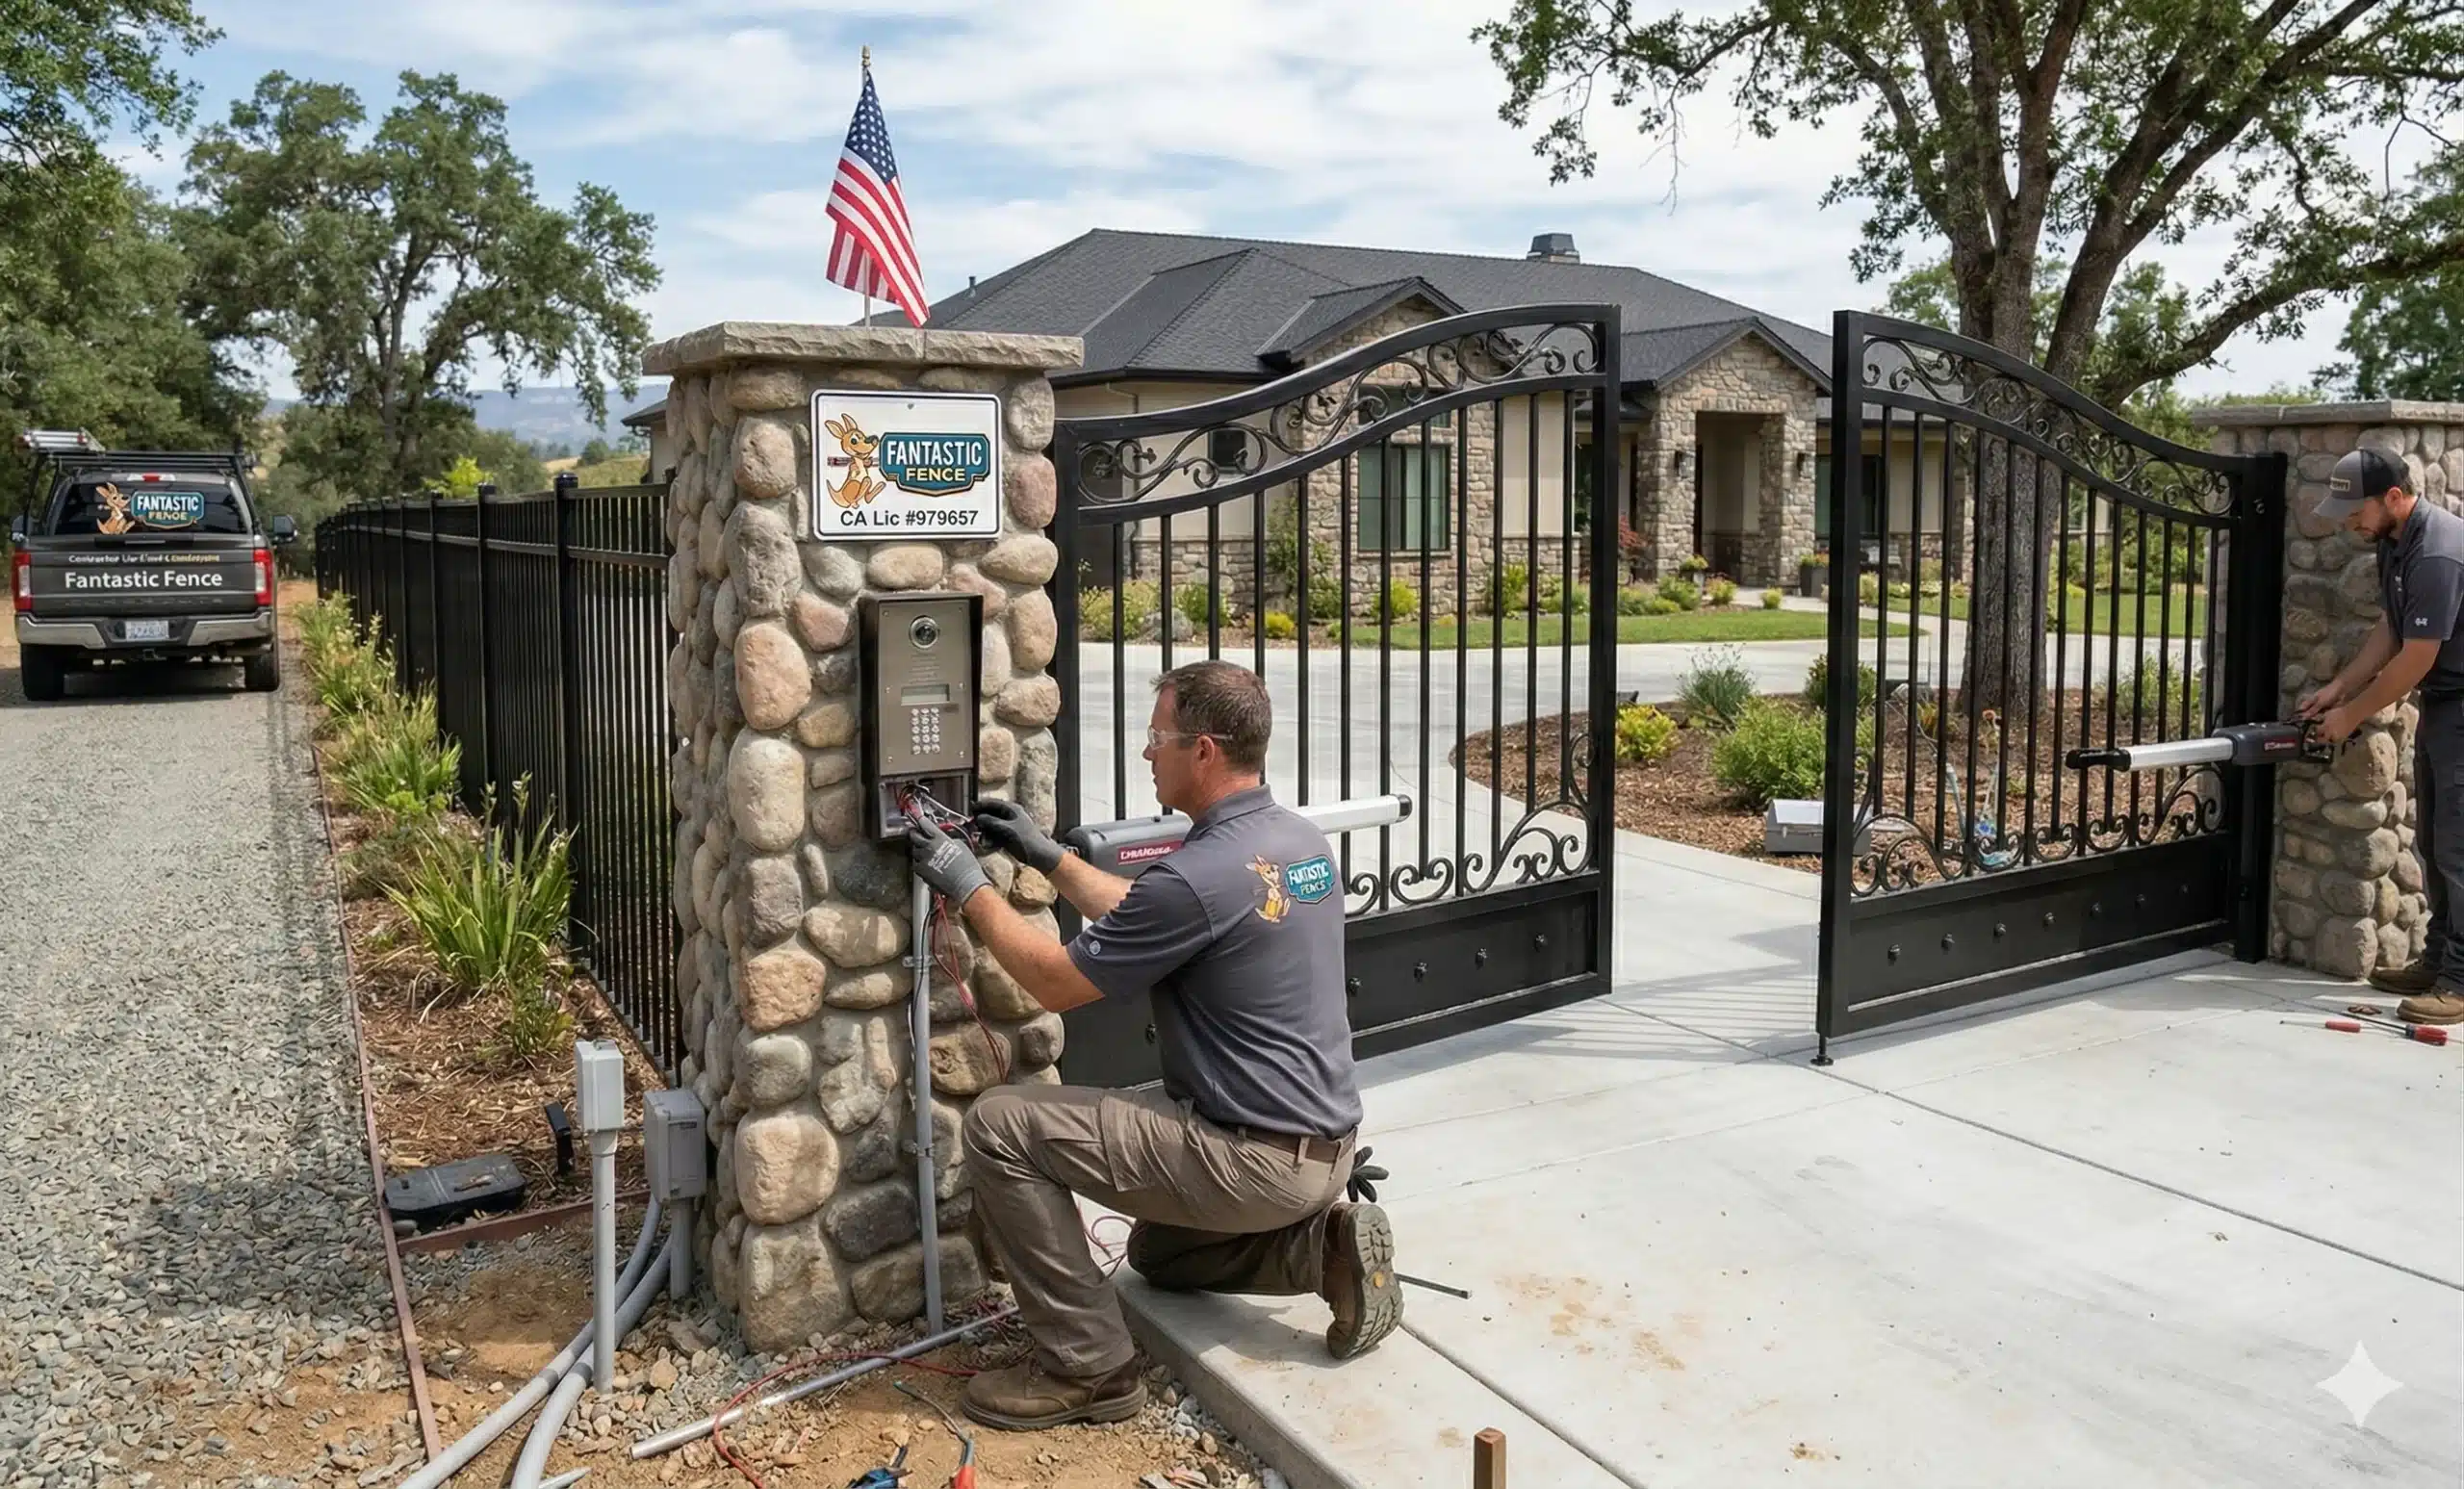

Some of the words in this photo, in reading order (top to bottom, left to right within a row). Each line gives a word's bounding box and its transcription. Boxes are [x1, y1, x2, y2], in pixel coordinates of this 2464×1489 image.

[886, 440, 982, 466] FANTASTIC
[906, 468, 966, 481] FENCE
[137, 495, 199, 512] FANTASTIC
[840, 510, 867, 526] CA
[874, 510, 900, 526] Lic
[905, 510, 979, 526] #979657
[64, 570, 160, 588] Fantastic
[164, 570, 223, 586] Fence
